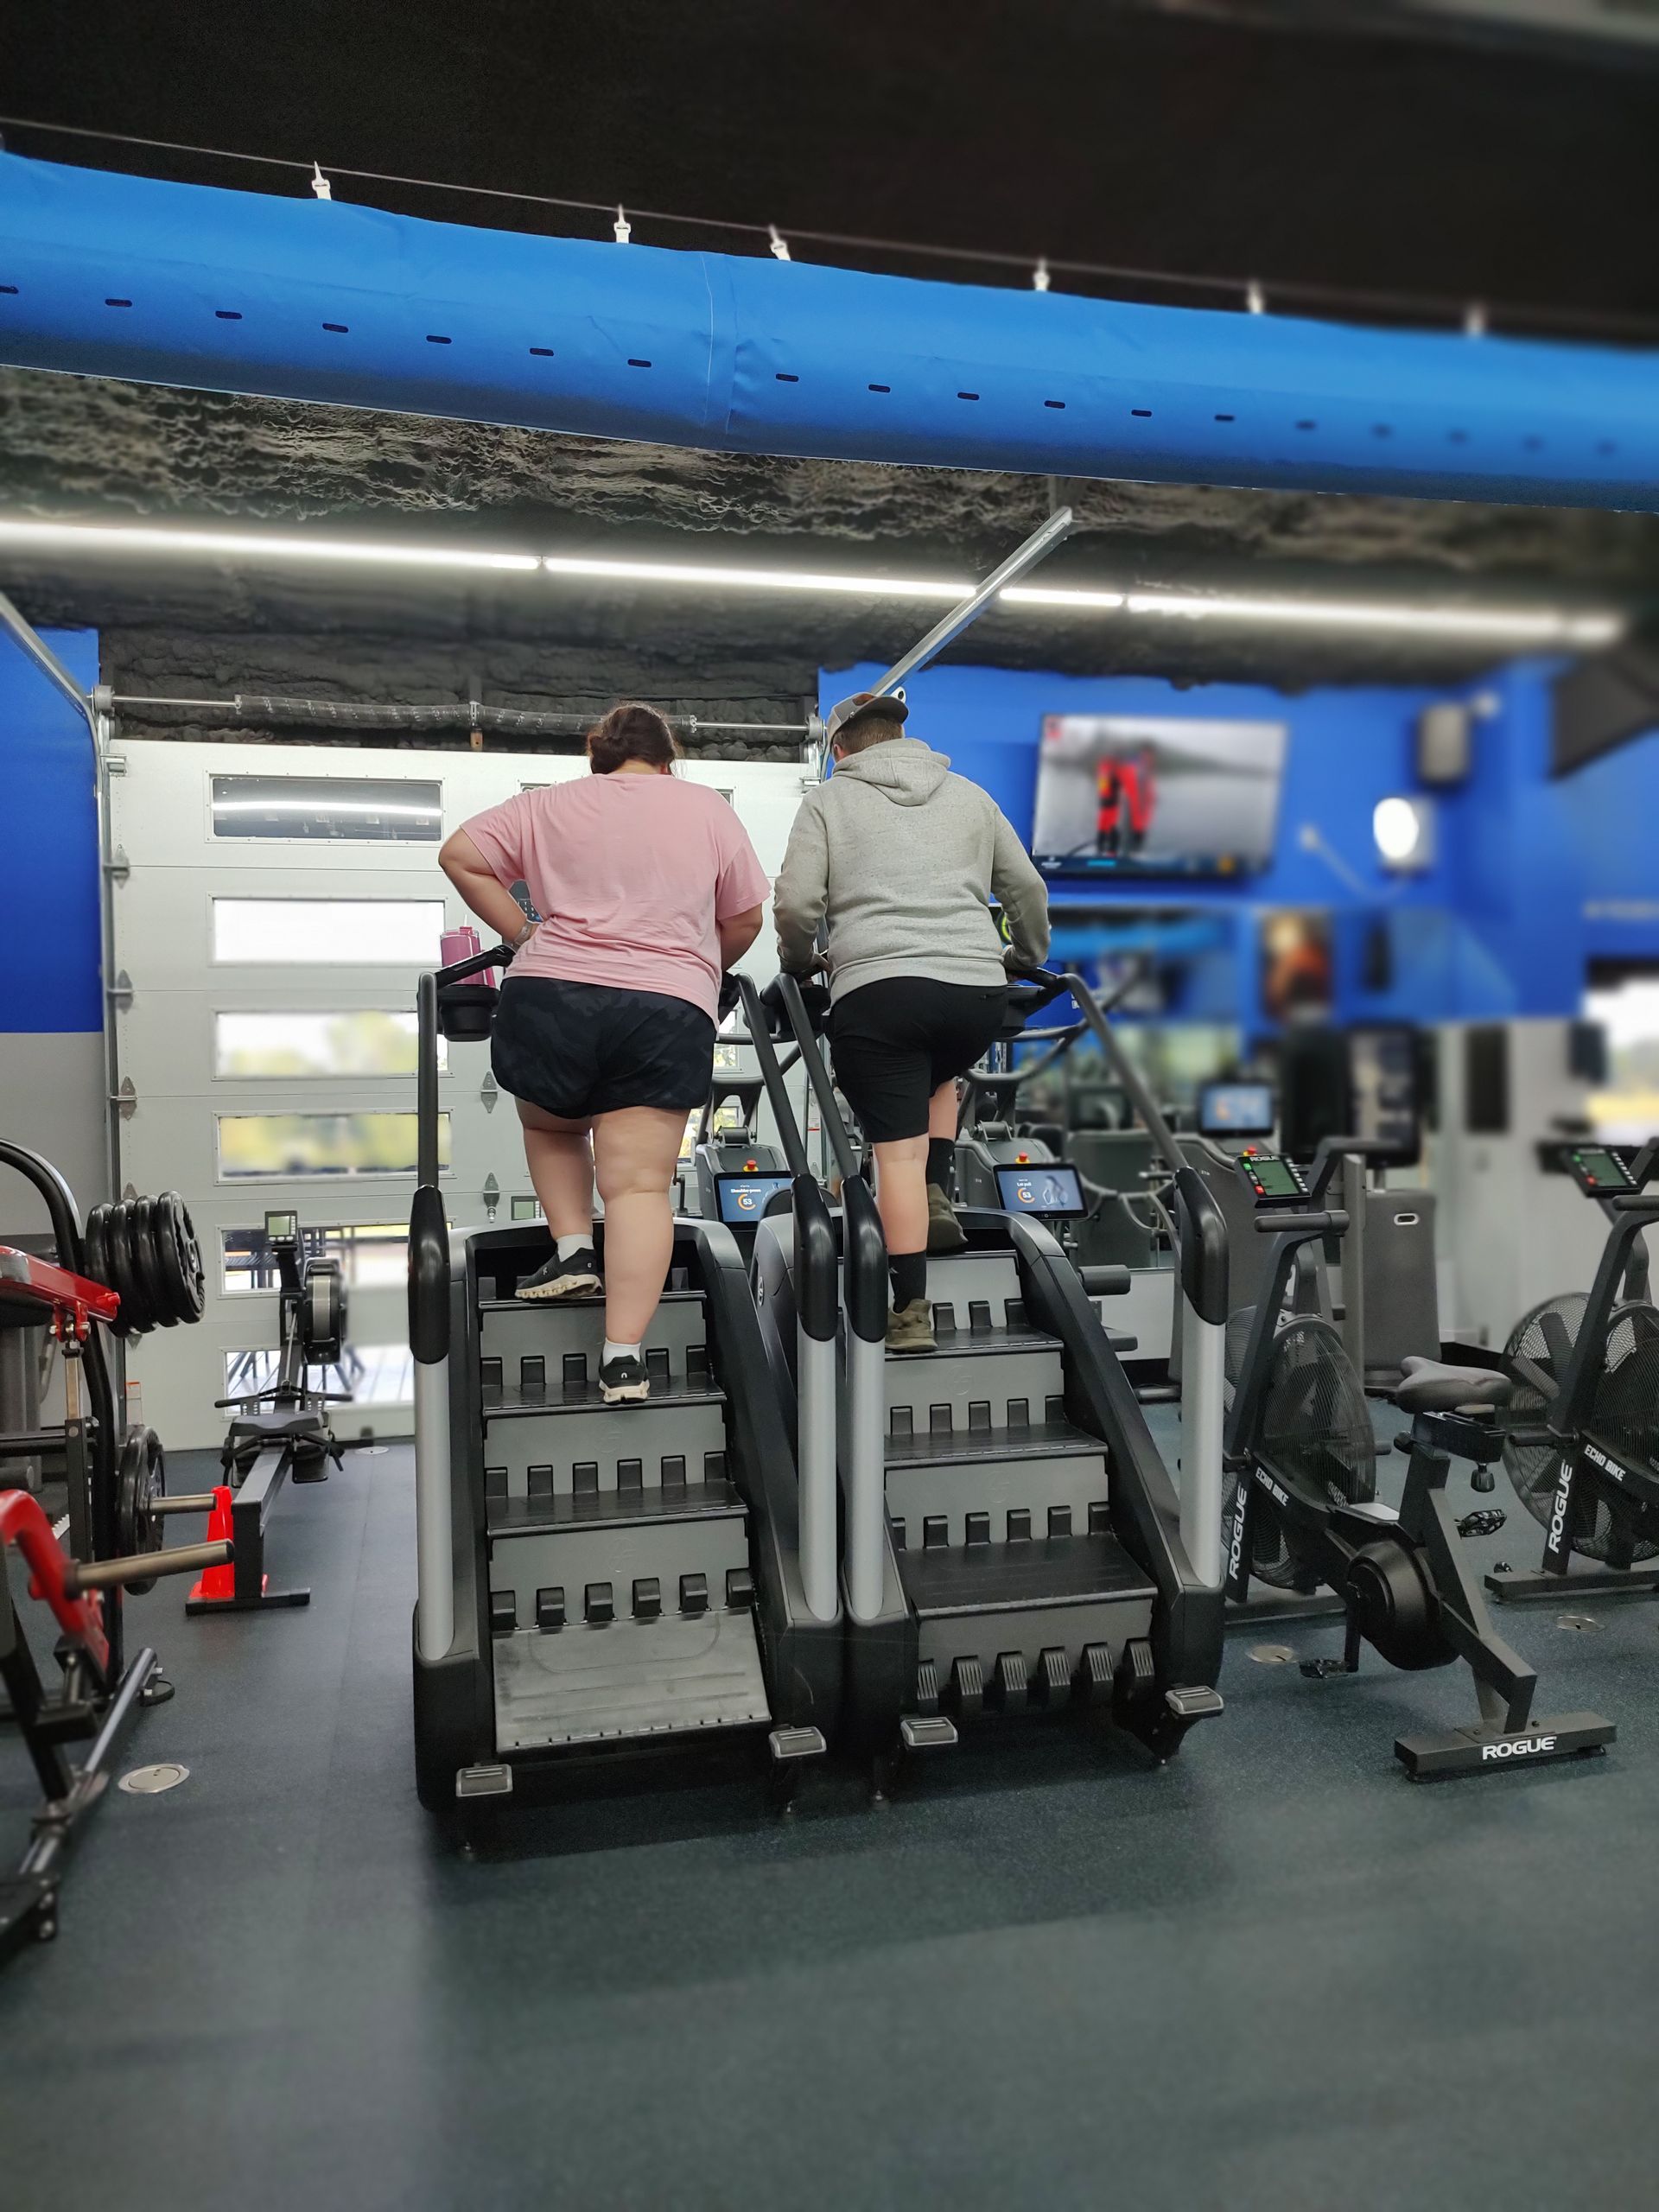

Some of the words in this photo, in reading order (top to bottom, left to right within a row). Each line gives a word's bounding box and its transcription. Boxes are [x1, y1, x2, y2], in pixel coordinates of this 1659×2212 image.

[1584, 1444, 1607, 1467] ECHO
[1605, 1459, 1626, 1482] BIKE
[1255, 1466, 1274, 1491] ECHO
[1272, 1484, 1289, 1506] BIKE
[1548, 1460, 1573, 1554] ROGUE
[1229, 1484, 1247, 1580] ROGUE
[1482, 1736, 1556, 1760] ROGUE
